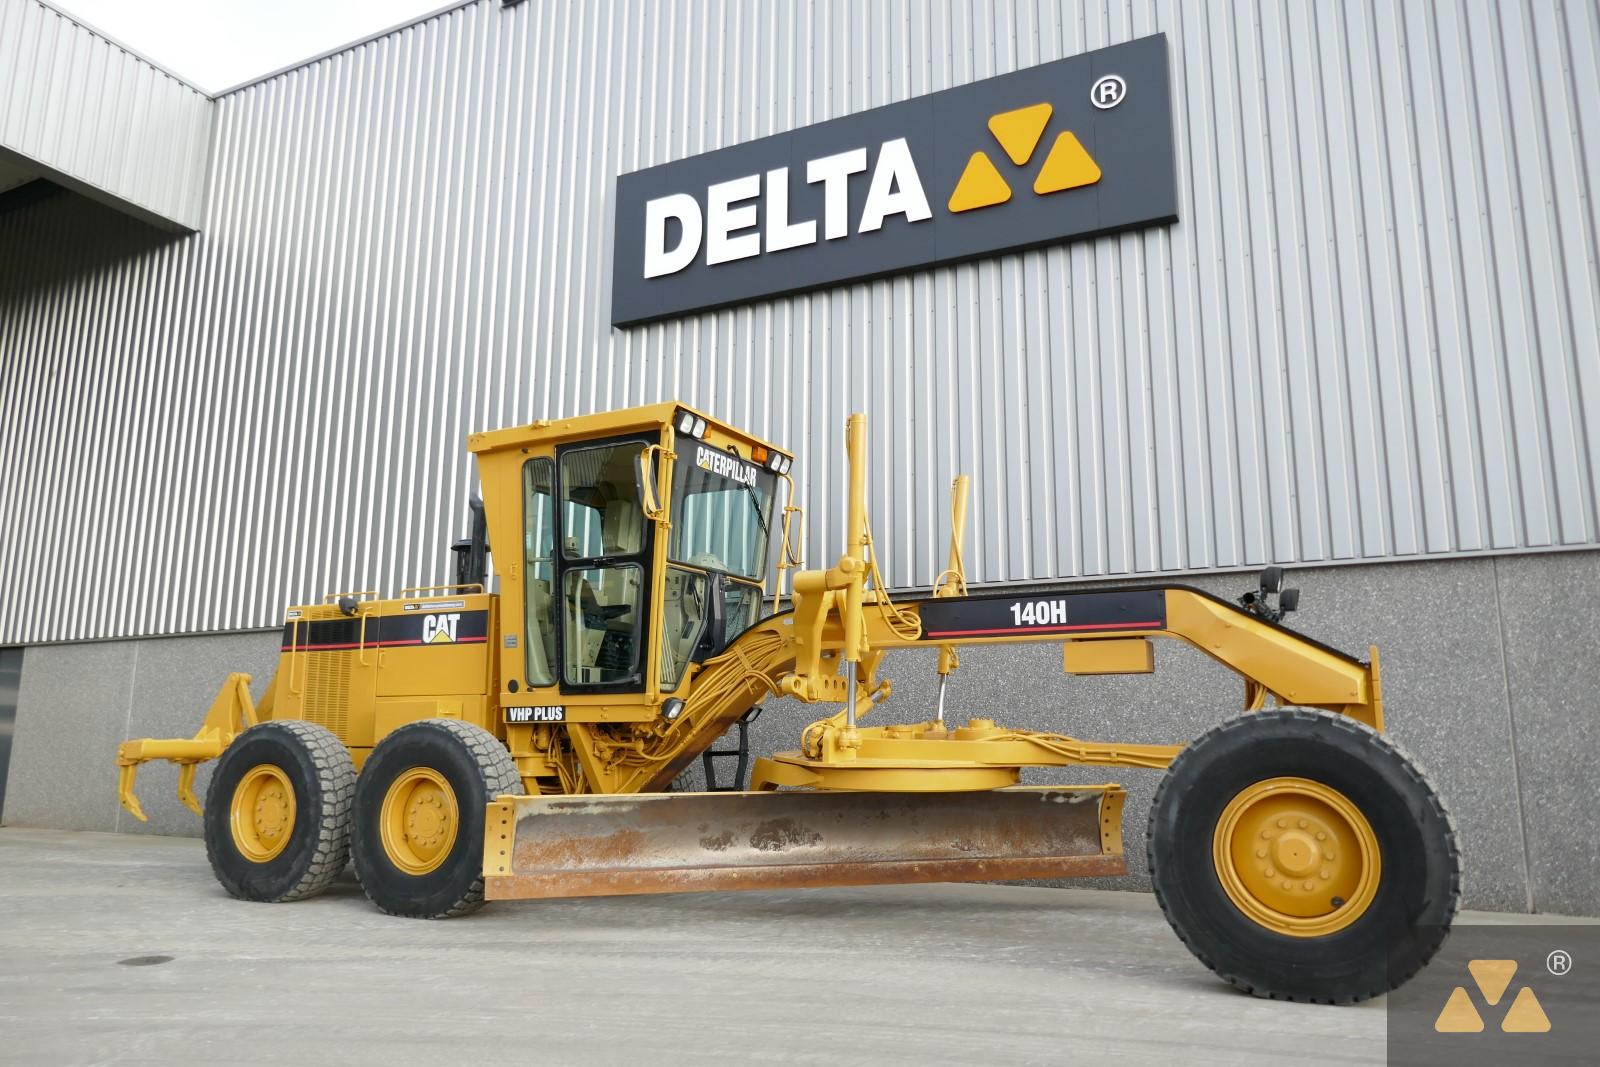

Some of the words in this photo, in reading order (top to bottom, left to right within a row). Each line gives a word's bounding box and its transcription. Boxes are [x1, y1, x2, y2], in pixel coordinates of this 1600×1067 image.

[644, 137, 932, 278] DELTA
[695, 446, 758, 487] CATERPILLAR
[1009, 599, 1067, 626] 140H
[421, 613, 461, 644] CAT
[509, 706, 533, 722] VHP
[534, 706, 564, 721] PLUS
